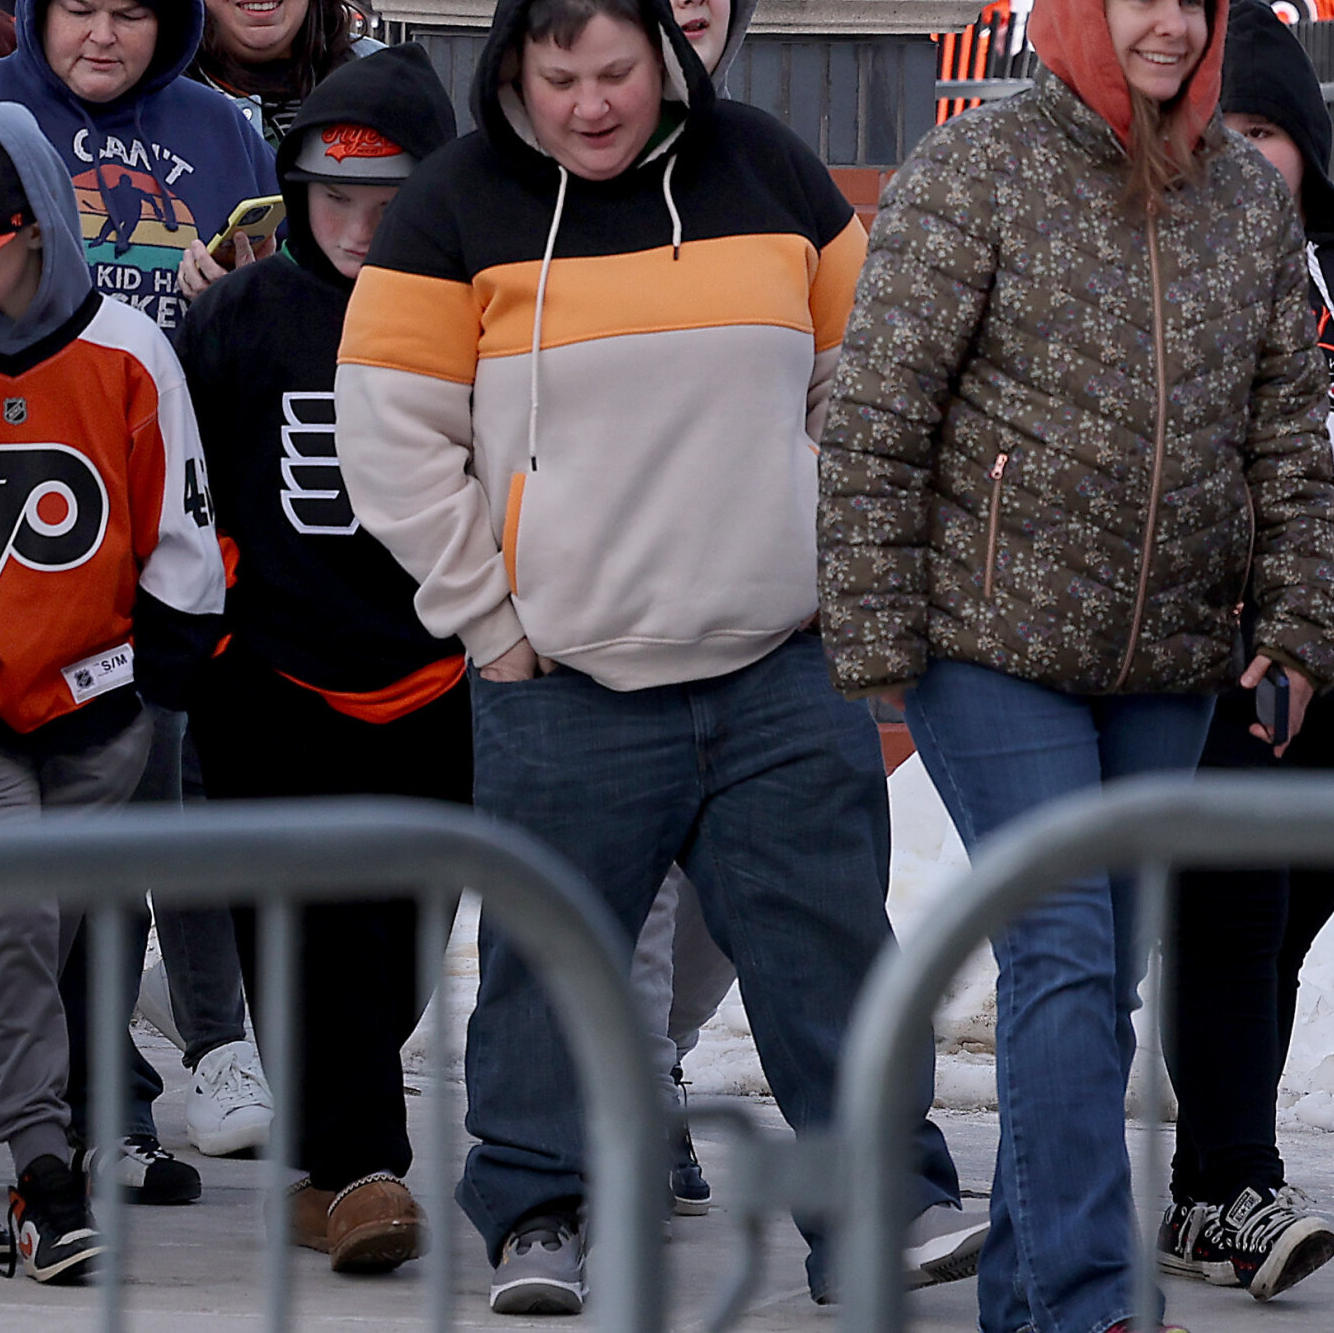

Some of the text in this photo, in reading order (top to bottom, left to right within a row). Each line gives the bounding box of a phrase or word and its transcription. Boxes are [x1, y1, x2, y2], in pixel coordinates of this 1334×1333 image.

[73, 128, 195, 186] CAN'T
[97, 265, 142, 290] KID
[101, 654, 128, 671] S/M
